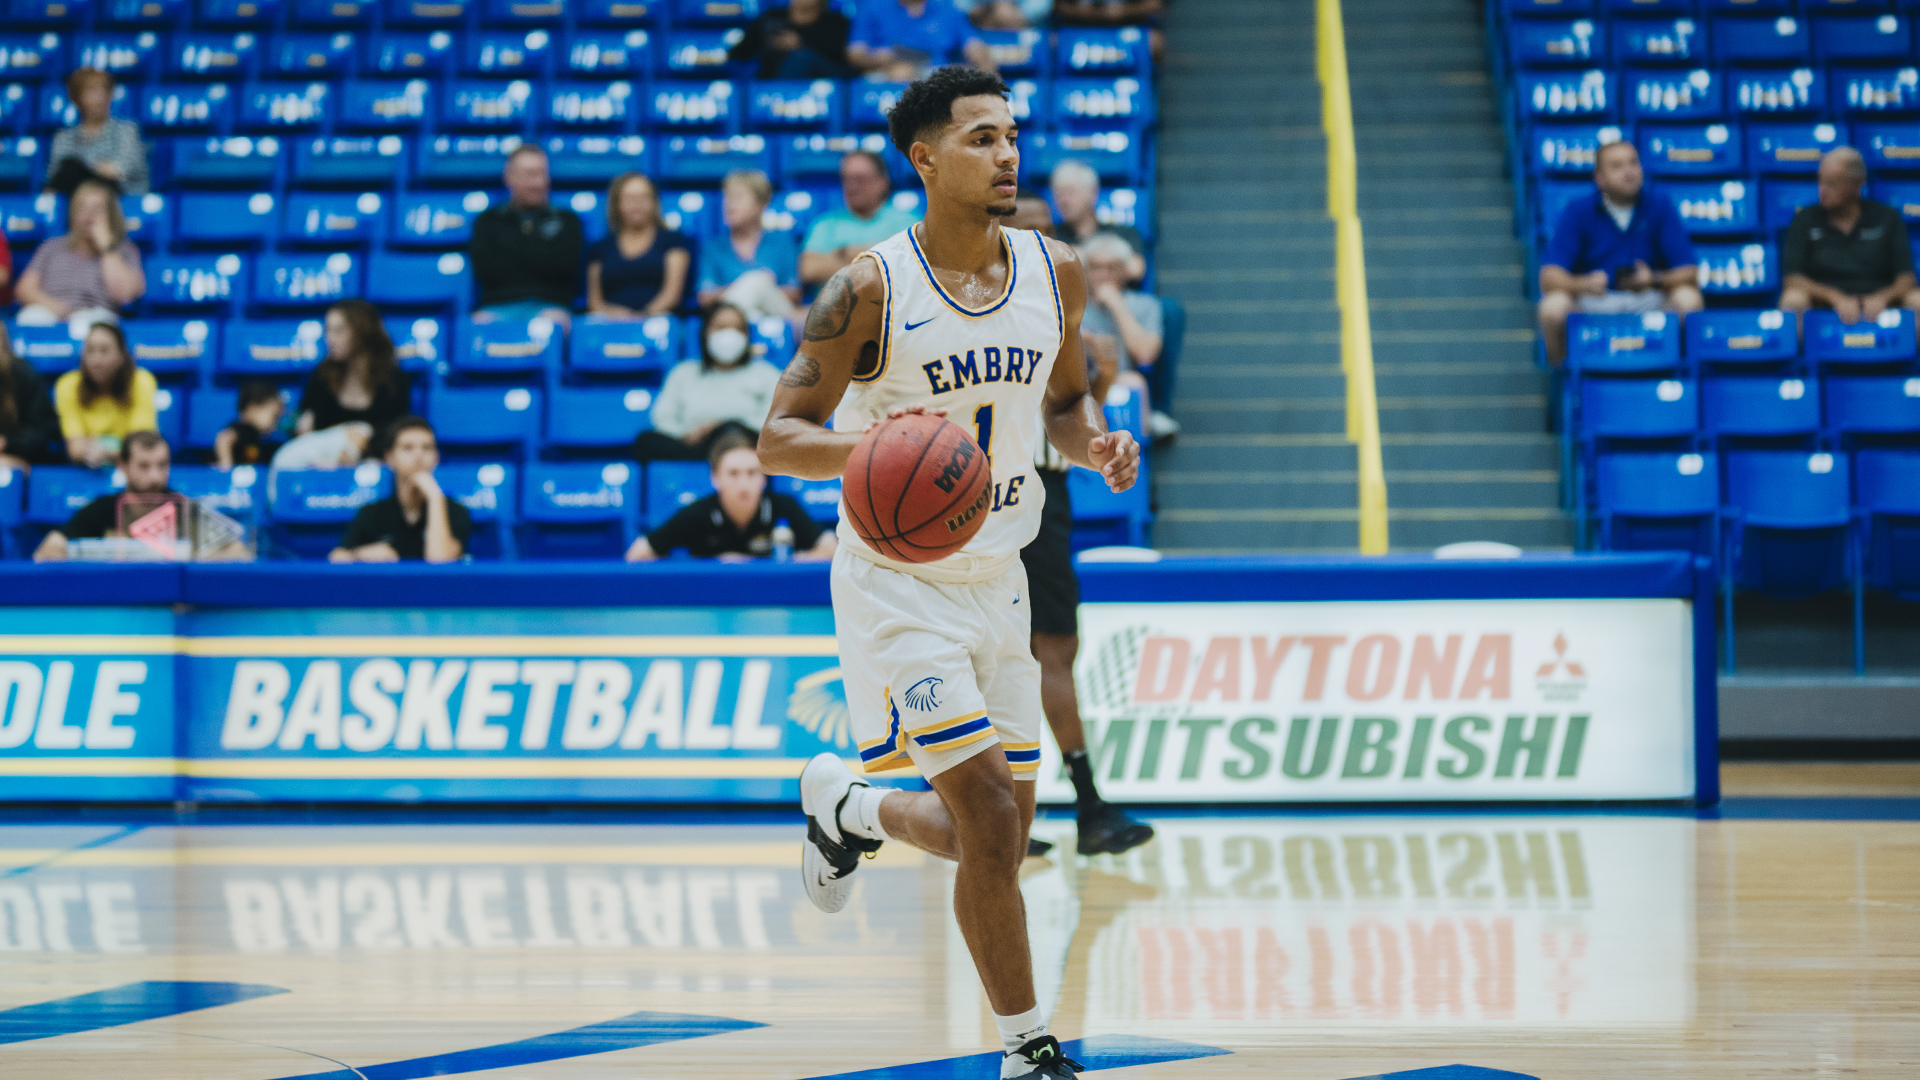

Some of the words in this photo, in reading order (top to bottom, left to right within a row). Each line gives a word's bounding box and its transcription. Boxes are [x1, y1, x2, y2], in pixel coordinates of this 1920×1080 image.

[921, 345, 1044, 396] EMBRY
[933, 434, 976, 494] NCAA
[971, 401, 995, 471] 1
[1133, 632, 1512, 704] DAYTONA
[0, 660, 148, 750] DLE
[220, 658, 782, 752] BASKETBALL
[1057, 714, 1592, 783] MITSUBISHI
